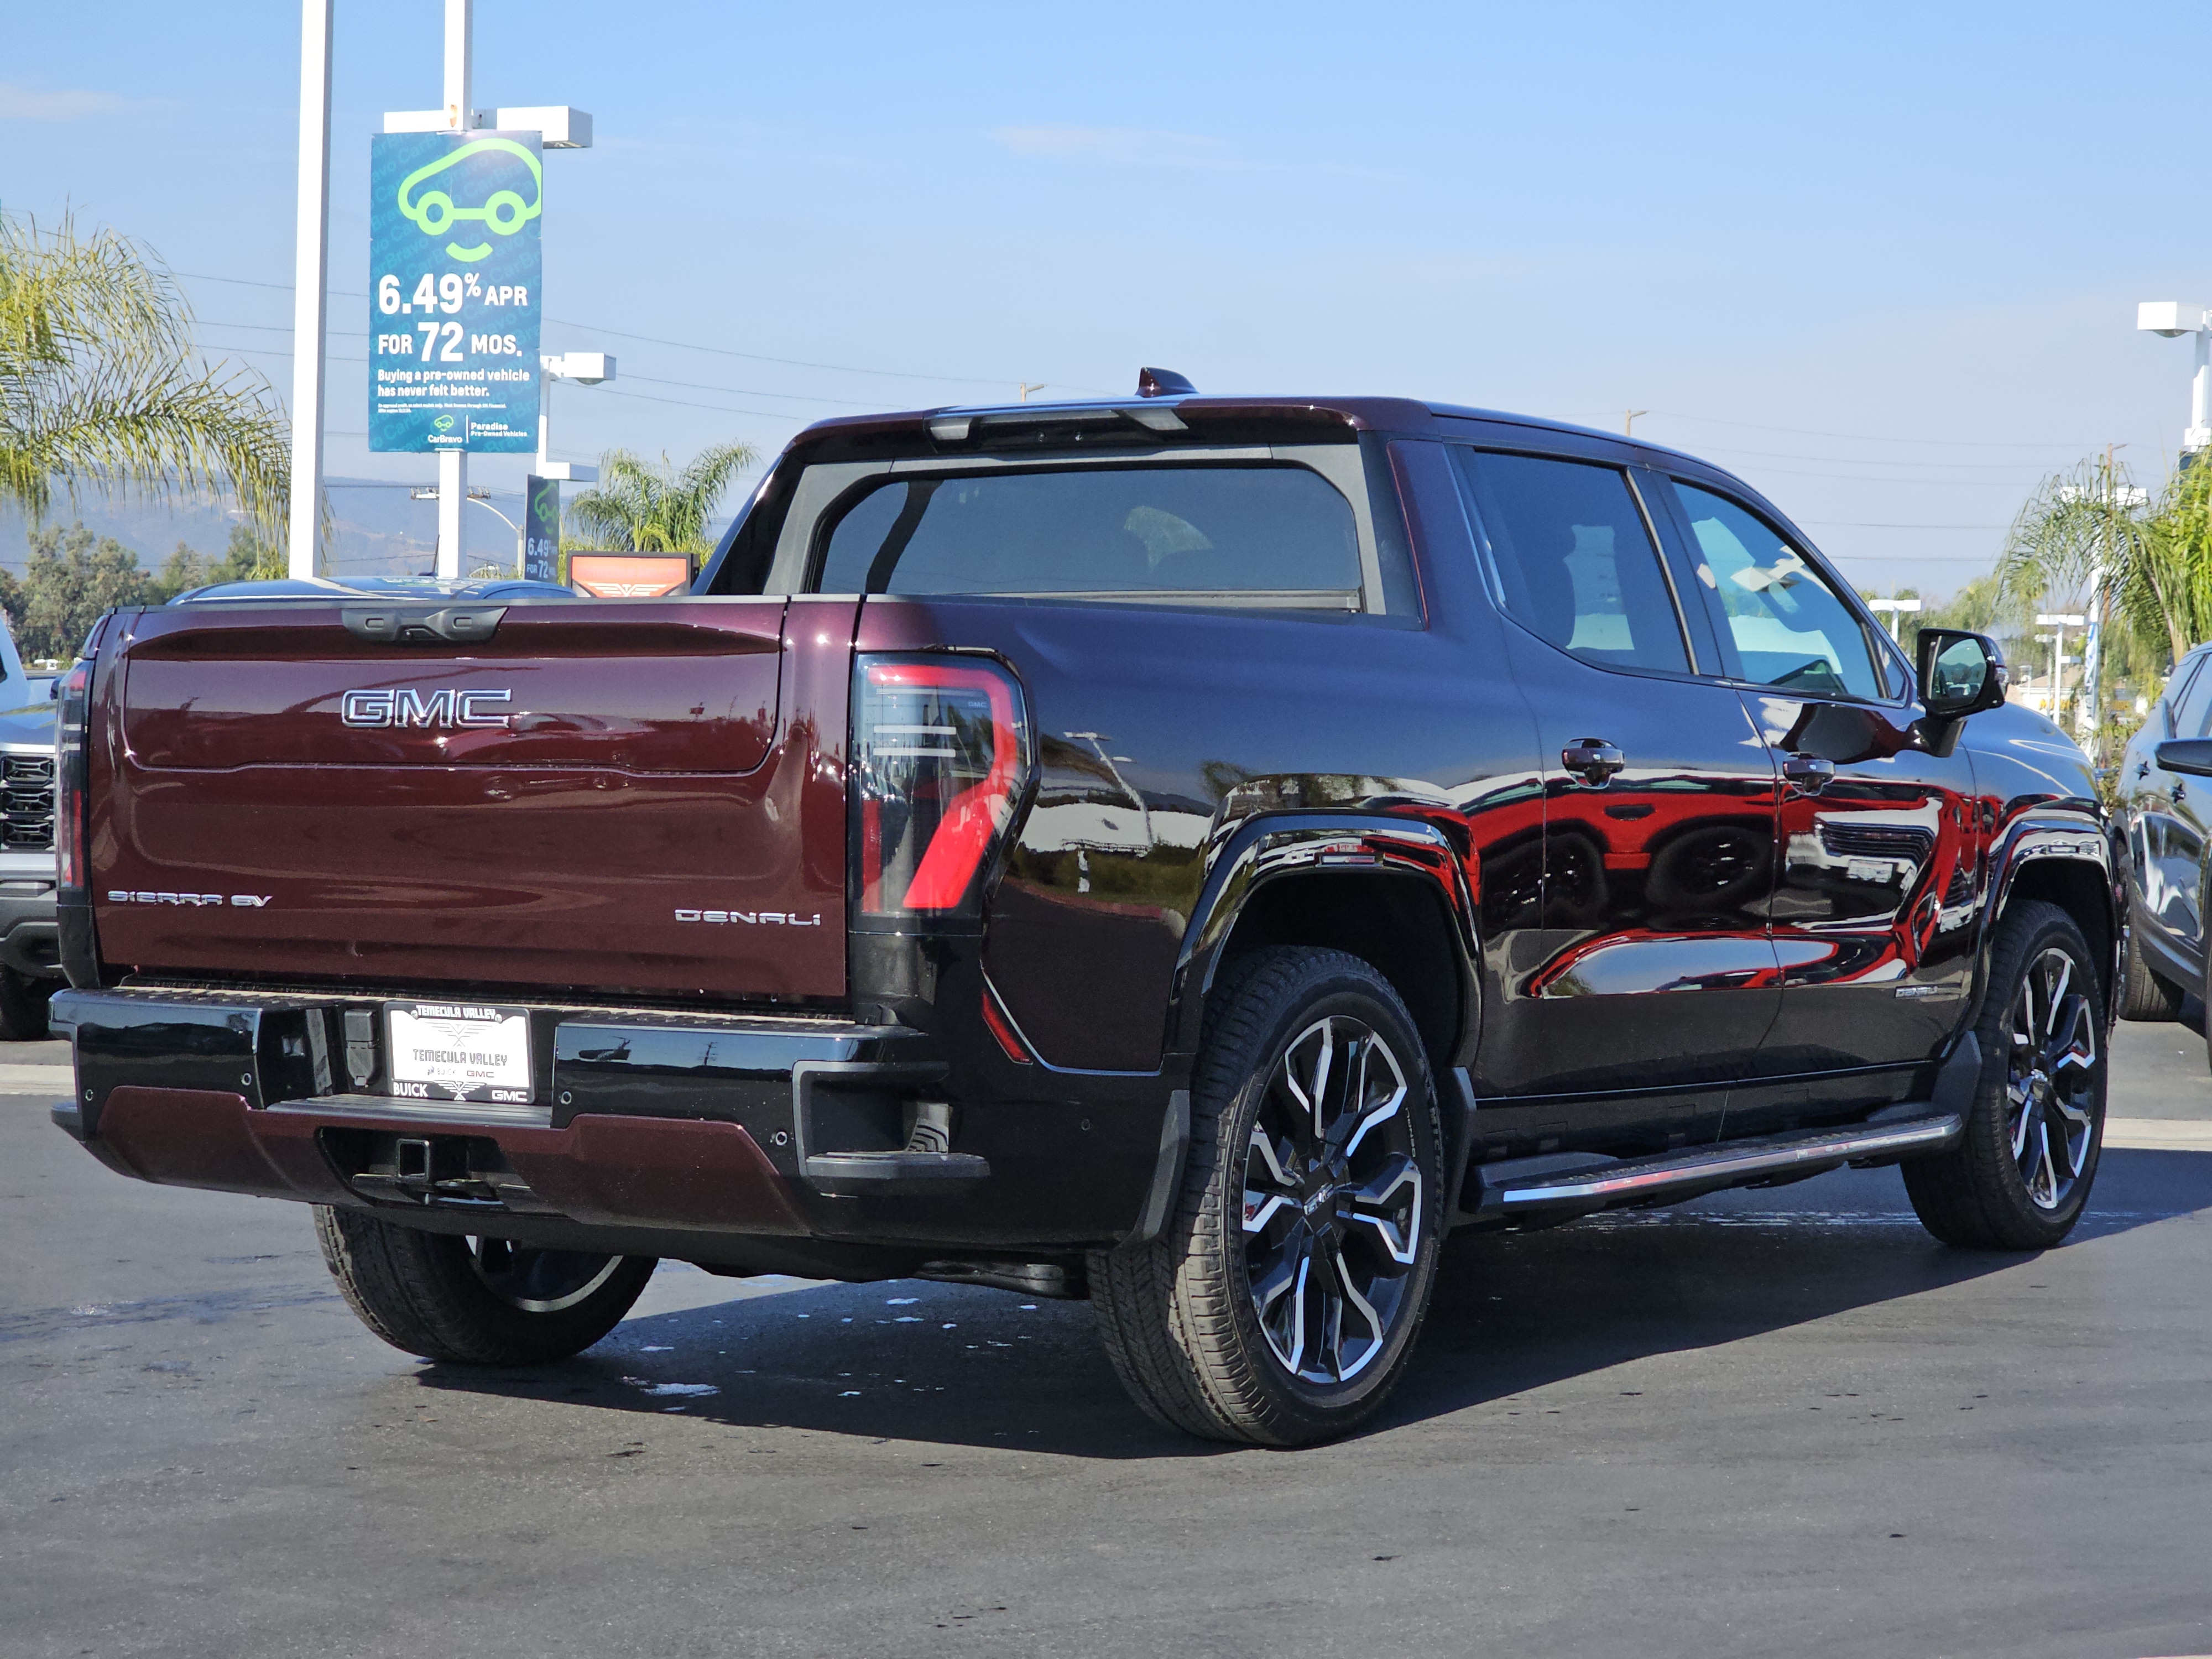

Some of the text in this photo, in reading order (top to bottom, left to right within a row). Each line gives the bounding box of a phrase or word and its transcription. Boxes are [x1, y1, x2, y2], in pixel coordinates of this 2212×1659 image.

[484, 285, 528, 306] APR
[378, 321, 522, 362] FOR 72 MOS.
[378, 368, 530, 383] Buying a pre-owned vehicle
[378, 384, 489, 397] has never felt better.
[471, 422, 508, 430] Paradise
[428, 435, 462, 443] CarBravo
[527, 564, 538, 573] FOR
[538, 560, 548, 579] 72
[342, 688, 511, 728] GMC
[108, 890, 273, 907] SIERRA EV
[675, 909, 821, 926] DENALI
[416, 1005, 495, 1019] TEMECULA VALLEY
[413, 1048, 508, 1066] TEMECULA VALLEY
[393, 1082, 528, 1102] BUICK GMC
